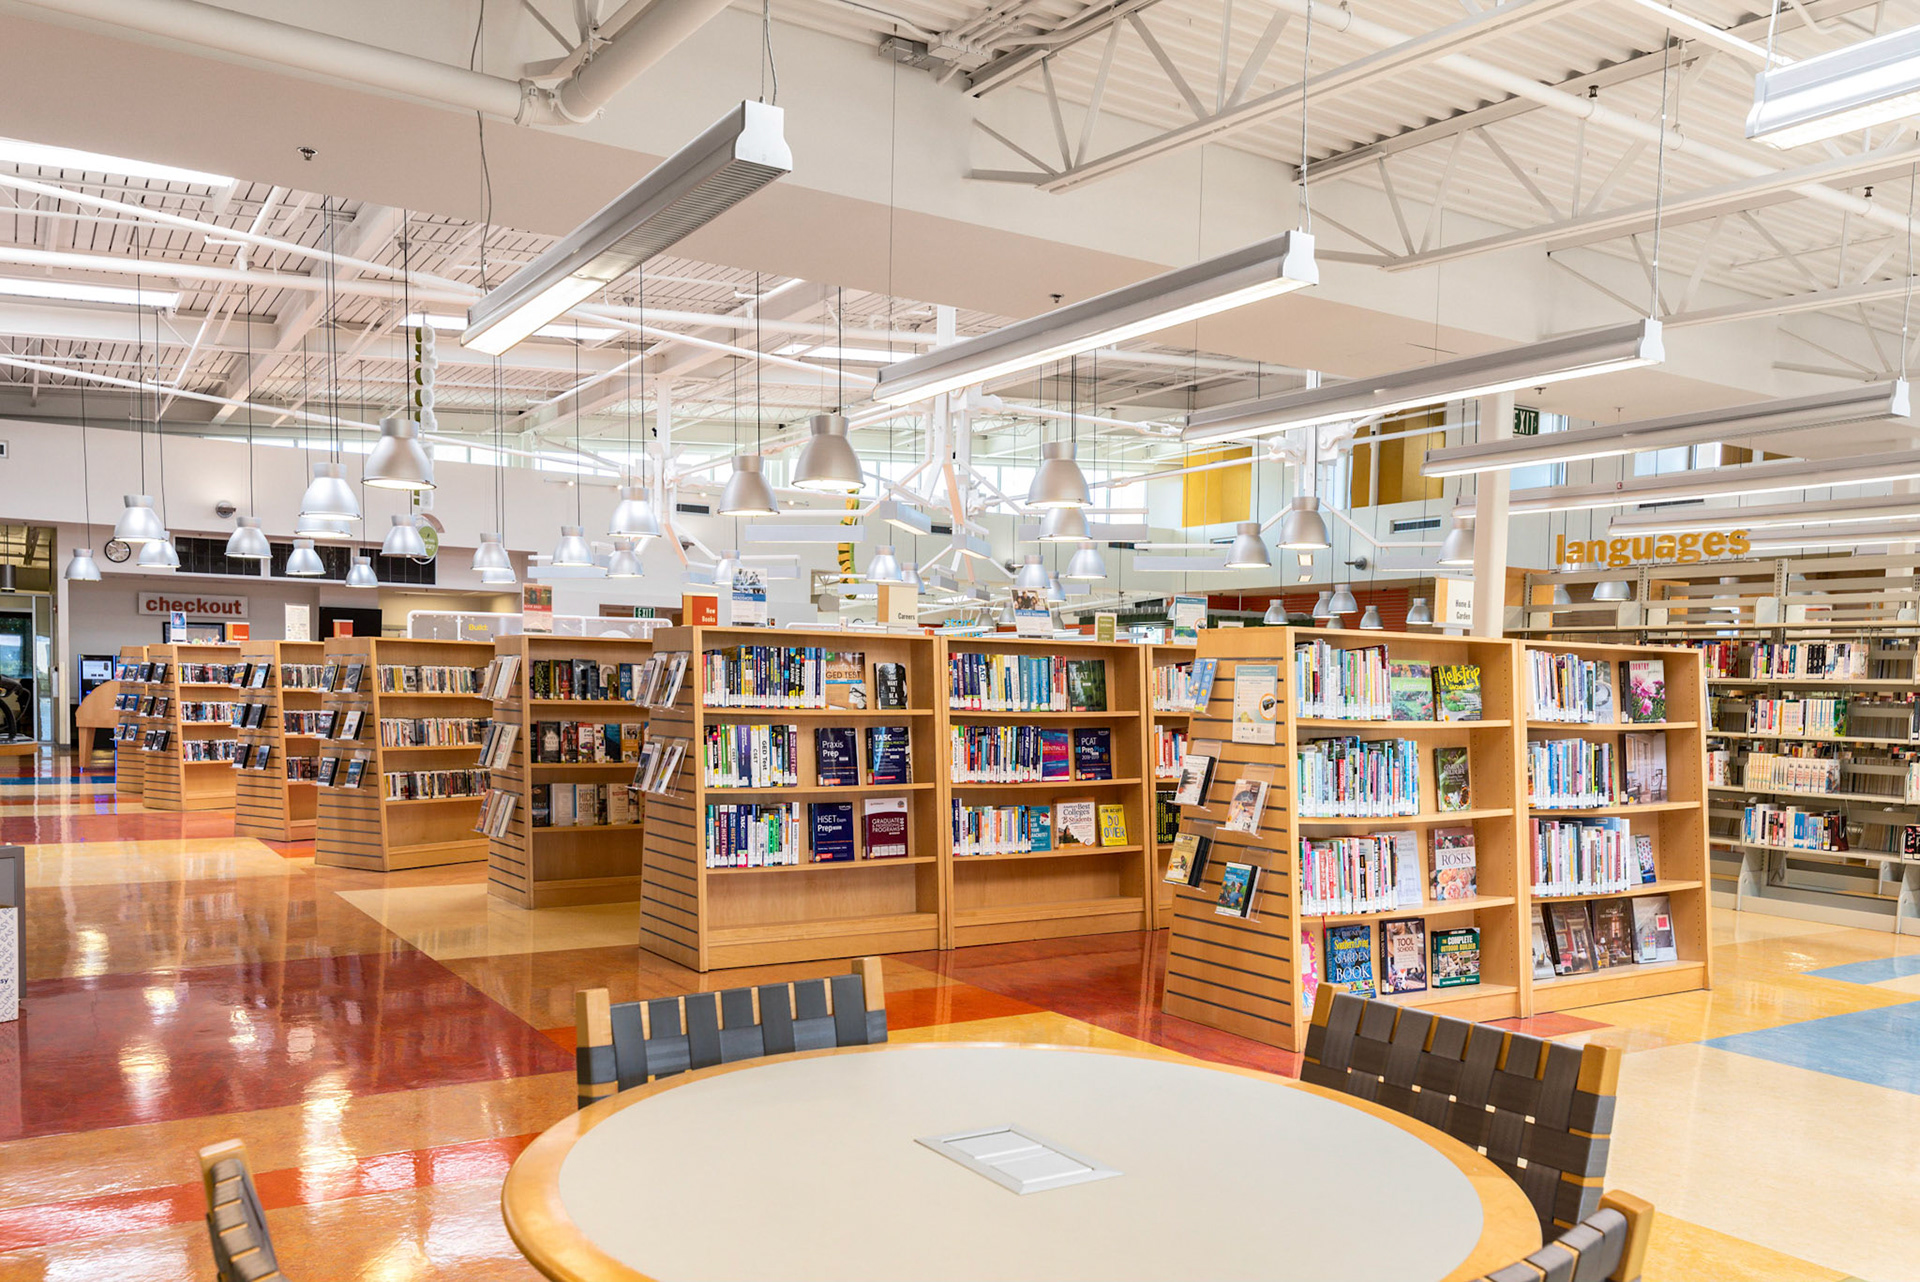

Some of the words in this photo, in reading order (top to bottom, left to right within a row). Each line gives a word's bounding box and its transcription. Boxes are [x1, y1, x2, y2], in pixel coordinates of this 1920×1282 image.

[1513, 409, 1536, 435] EXIT
[1556, 528, 1752, 568] languages
[145, 596, 242, 615] checkout
[1455, 600, 1467, 608] Home
[637, 607, 653, 618] EXIT
[897, 612, 916, 620] Careers
[1456, 611, 1471, 620] Garden
[701, 615, 716, 623] Books
[826, 671, 843, 679] GED
[845, 670, 862, 679] TEST
[1438, 665, 1480, 686] Hellstrip
[822, 740, 844, 749] Praxis
[1081, 737, 1097, 745] PCAT
[822, 749, 839, 758] Prep
[1063, 809, 1090, 817] Colleges
[817, 815, 837, 823] HiSET
[1107, 815, 1119, 826] DO
[817, 824, 833, 833] Prep
[1103, 827, 1125, 838] OVER
[1441, 852, 1472, 866] ROSES
[1334, 938, 1355, 950] Southern
[1355, 937, 1369, 949] Living
[1397, 937, 1414, 946] TOOL
[1448, 935, 1473, 945] COMPLETE
[1335, 951, 1369, 963] GARDEN
[1336, 965, 1371, 981] BOOK
